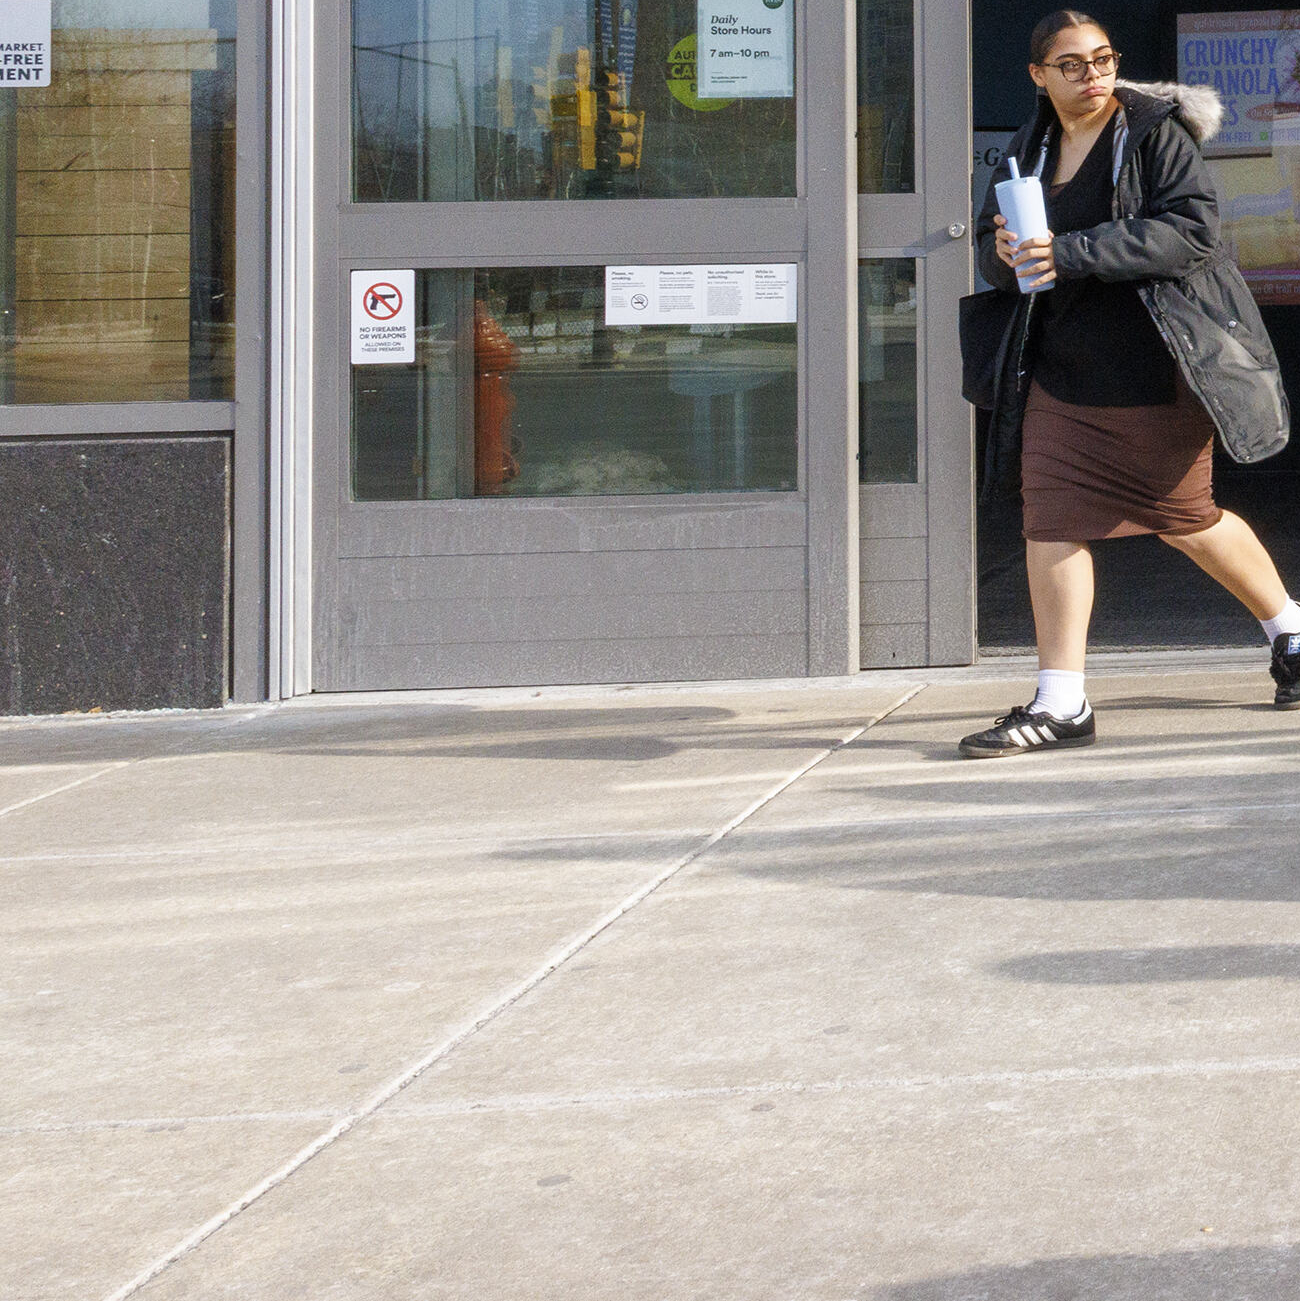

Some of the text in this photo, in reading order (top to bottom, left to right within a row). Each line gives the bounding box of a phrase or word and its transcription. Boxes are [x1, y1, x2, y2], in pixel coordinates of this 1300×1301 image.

[710, 15, 739, 25] Daily
[711, 26, 772, 35] Store Hours
[710, 49, 717, 58] 7
[753, 50, 770, 59] pm
[1184, 38, 1278, 67] CRUNCHY
[0, 68, 43, 80] ENT
